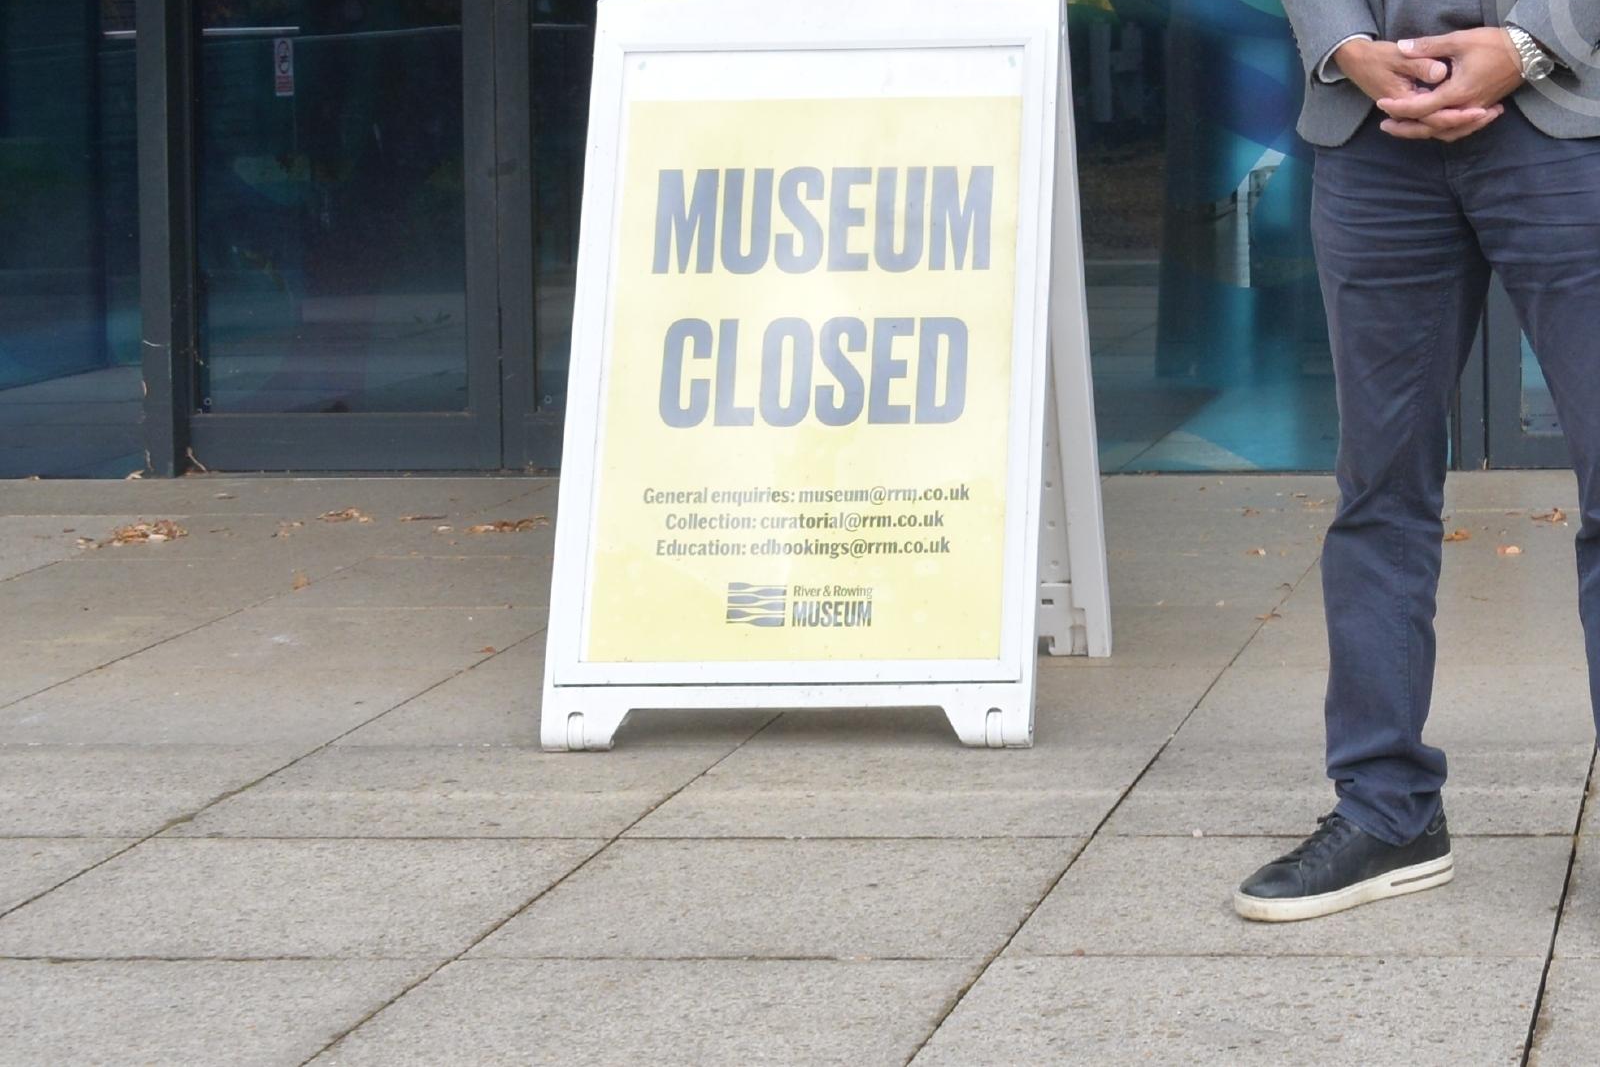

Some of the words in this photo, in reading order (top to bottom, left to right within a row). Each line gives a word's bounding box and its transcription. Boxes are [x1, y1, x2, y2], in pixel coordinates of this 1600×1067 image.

[651, 166, 995, 275] MUSEUM
[658, 316, 969, 429] CLOSED
[643, 487, 708, 504] General
[711, 487, 796, 507] enquiries:
[798, 484, 970, 505] museum@rrm.co.uk
[665, 512, 756, 530] Collection:
[760, 510, 944, 532] curatorial@rrm.co.uk
[655, 538, 747, 556] Education:
[750, 536, 951, 559] edbookings@rrm.co.uk
[793, 584, 822, 597] River
[822, 585, 832, 597] &
[833, 584, 873, 599] Rowing
[792, 600, 873, 627] MUSEUM
